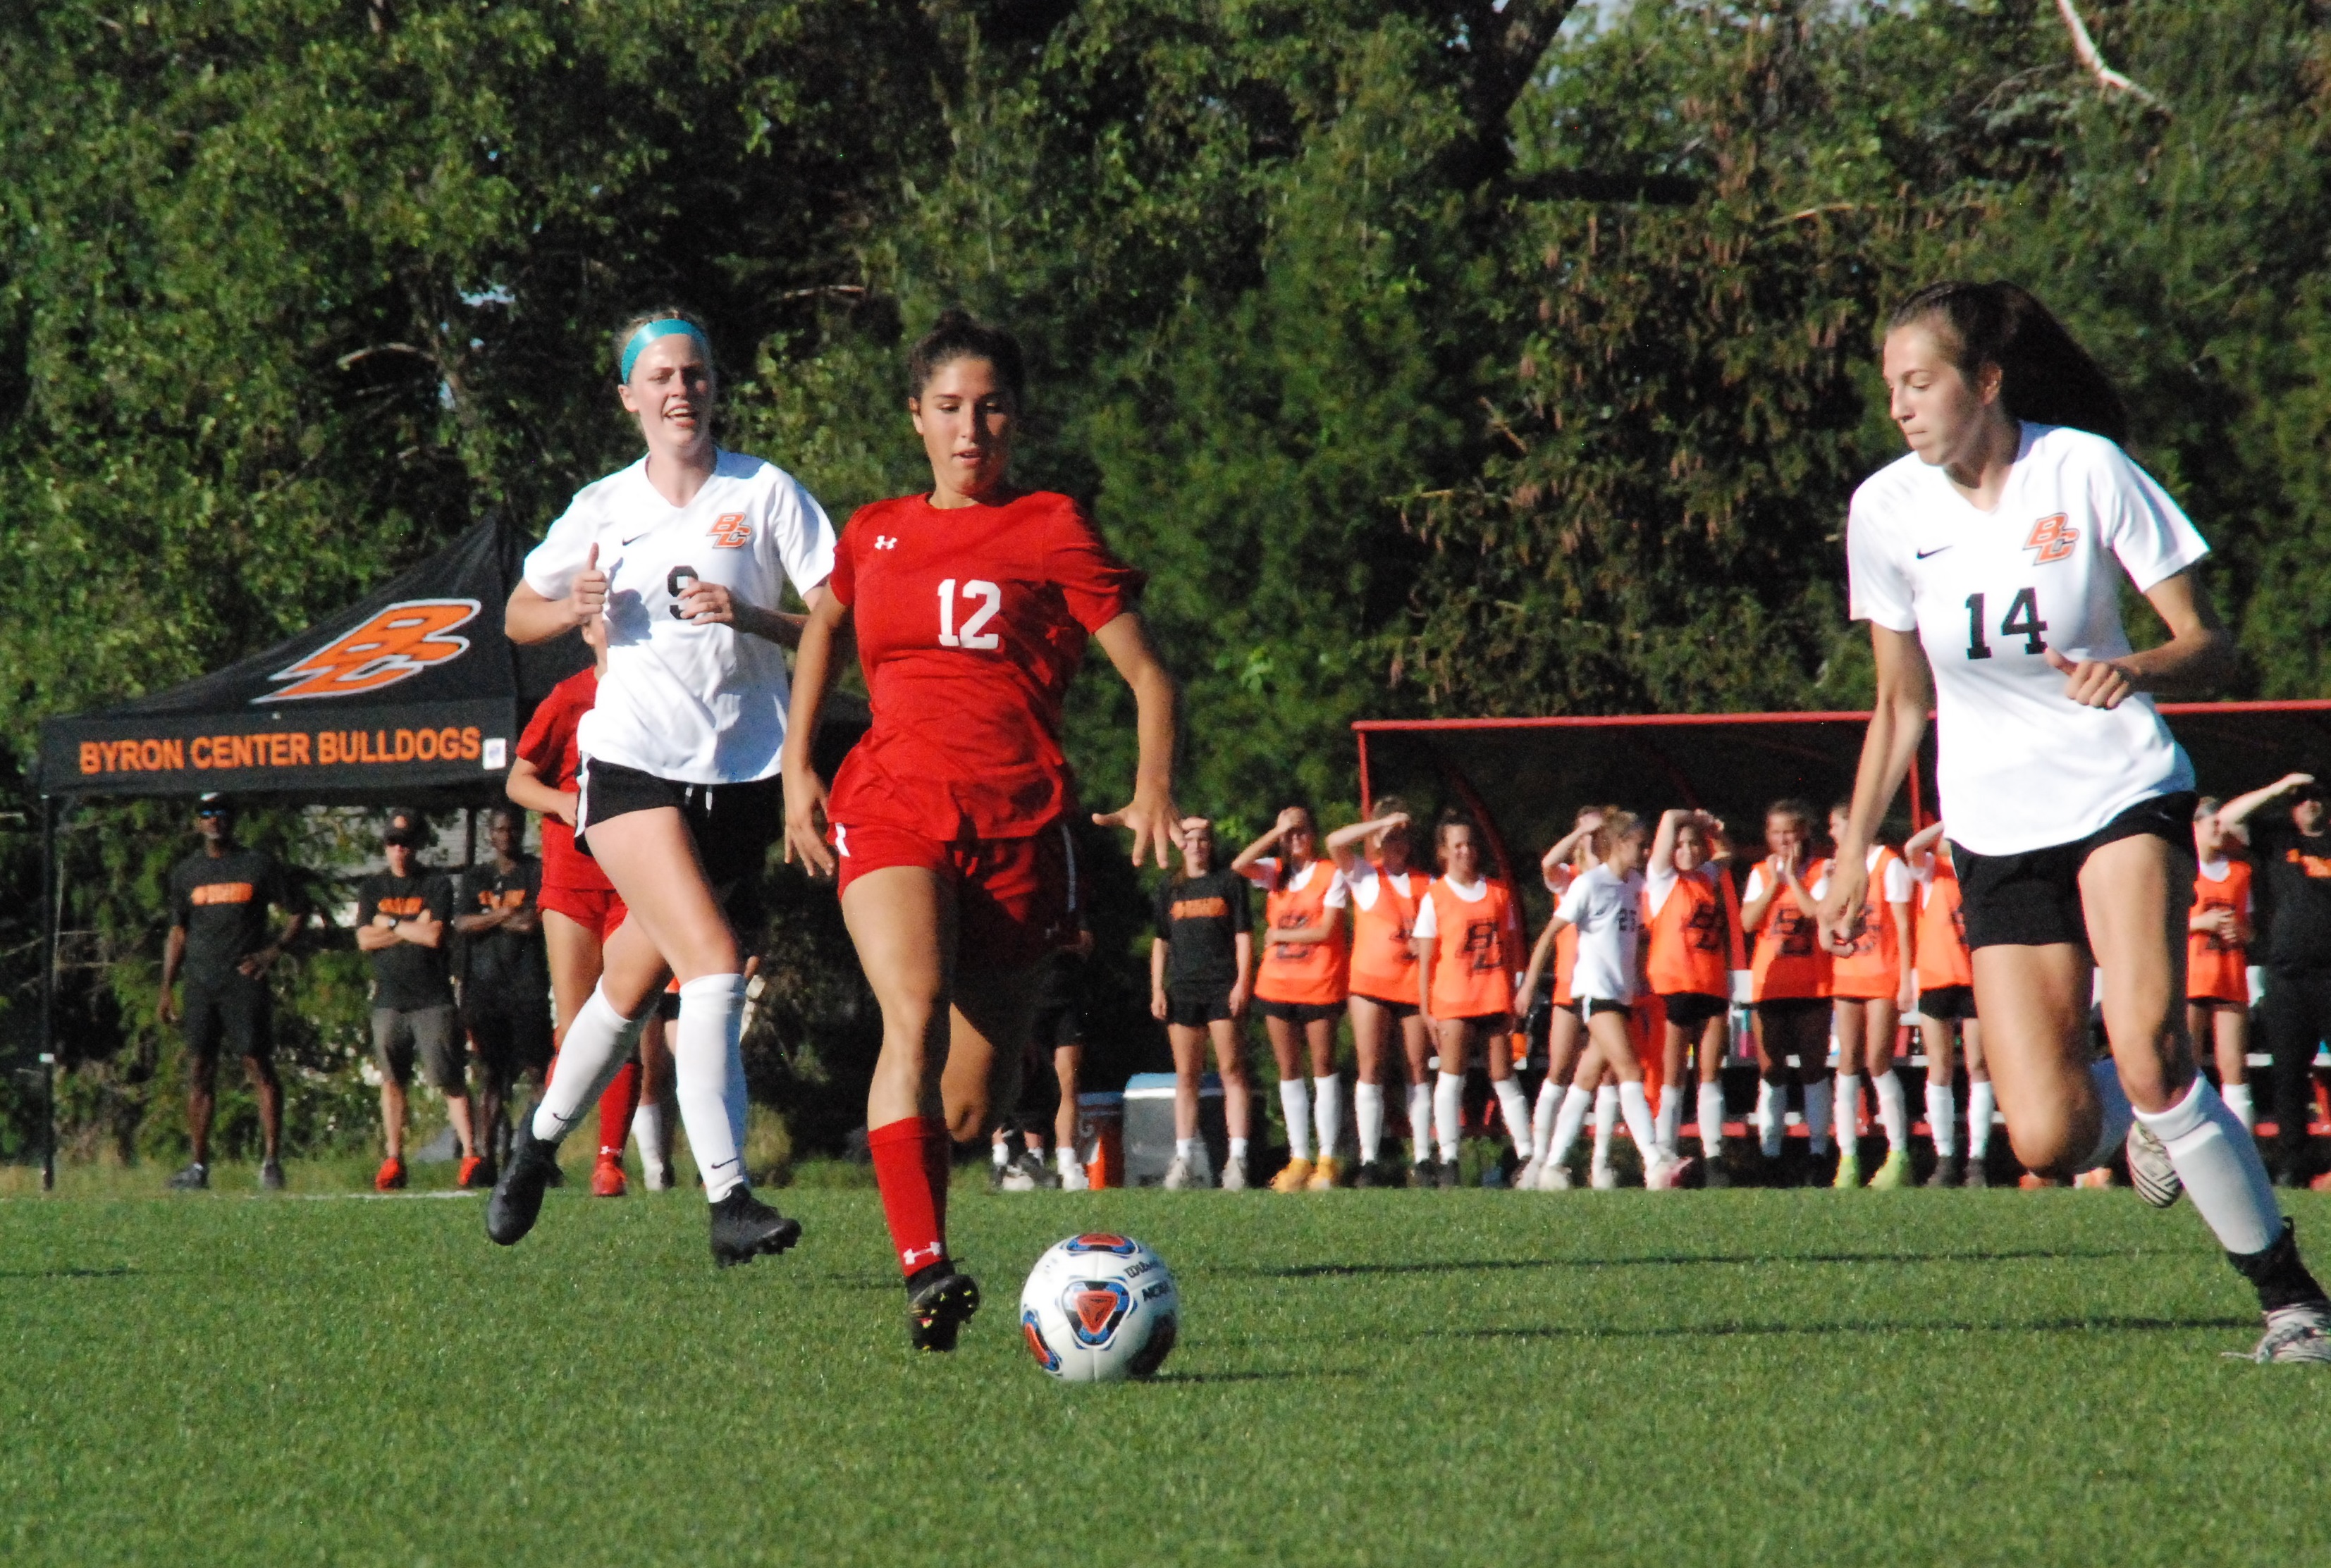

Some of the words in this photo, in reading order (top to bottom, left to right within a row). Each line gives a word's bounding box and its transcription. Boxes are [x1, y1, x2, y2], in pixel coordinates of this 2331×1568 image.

[707, 512, 753, 549] BC
[2023, 512, 2080, 566] BC
[937, 579, 1002, 650] 12
[1965, 587, 2048, 660] 14
[251, 598, 481, 704] BC
[80, 739, 184, 774] BYRON
[190, 733, 310, 769] CENTER
[318, 727, 481, 765] BULLDOGS
